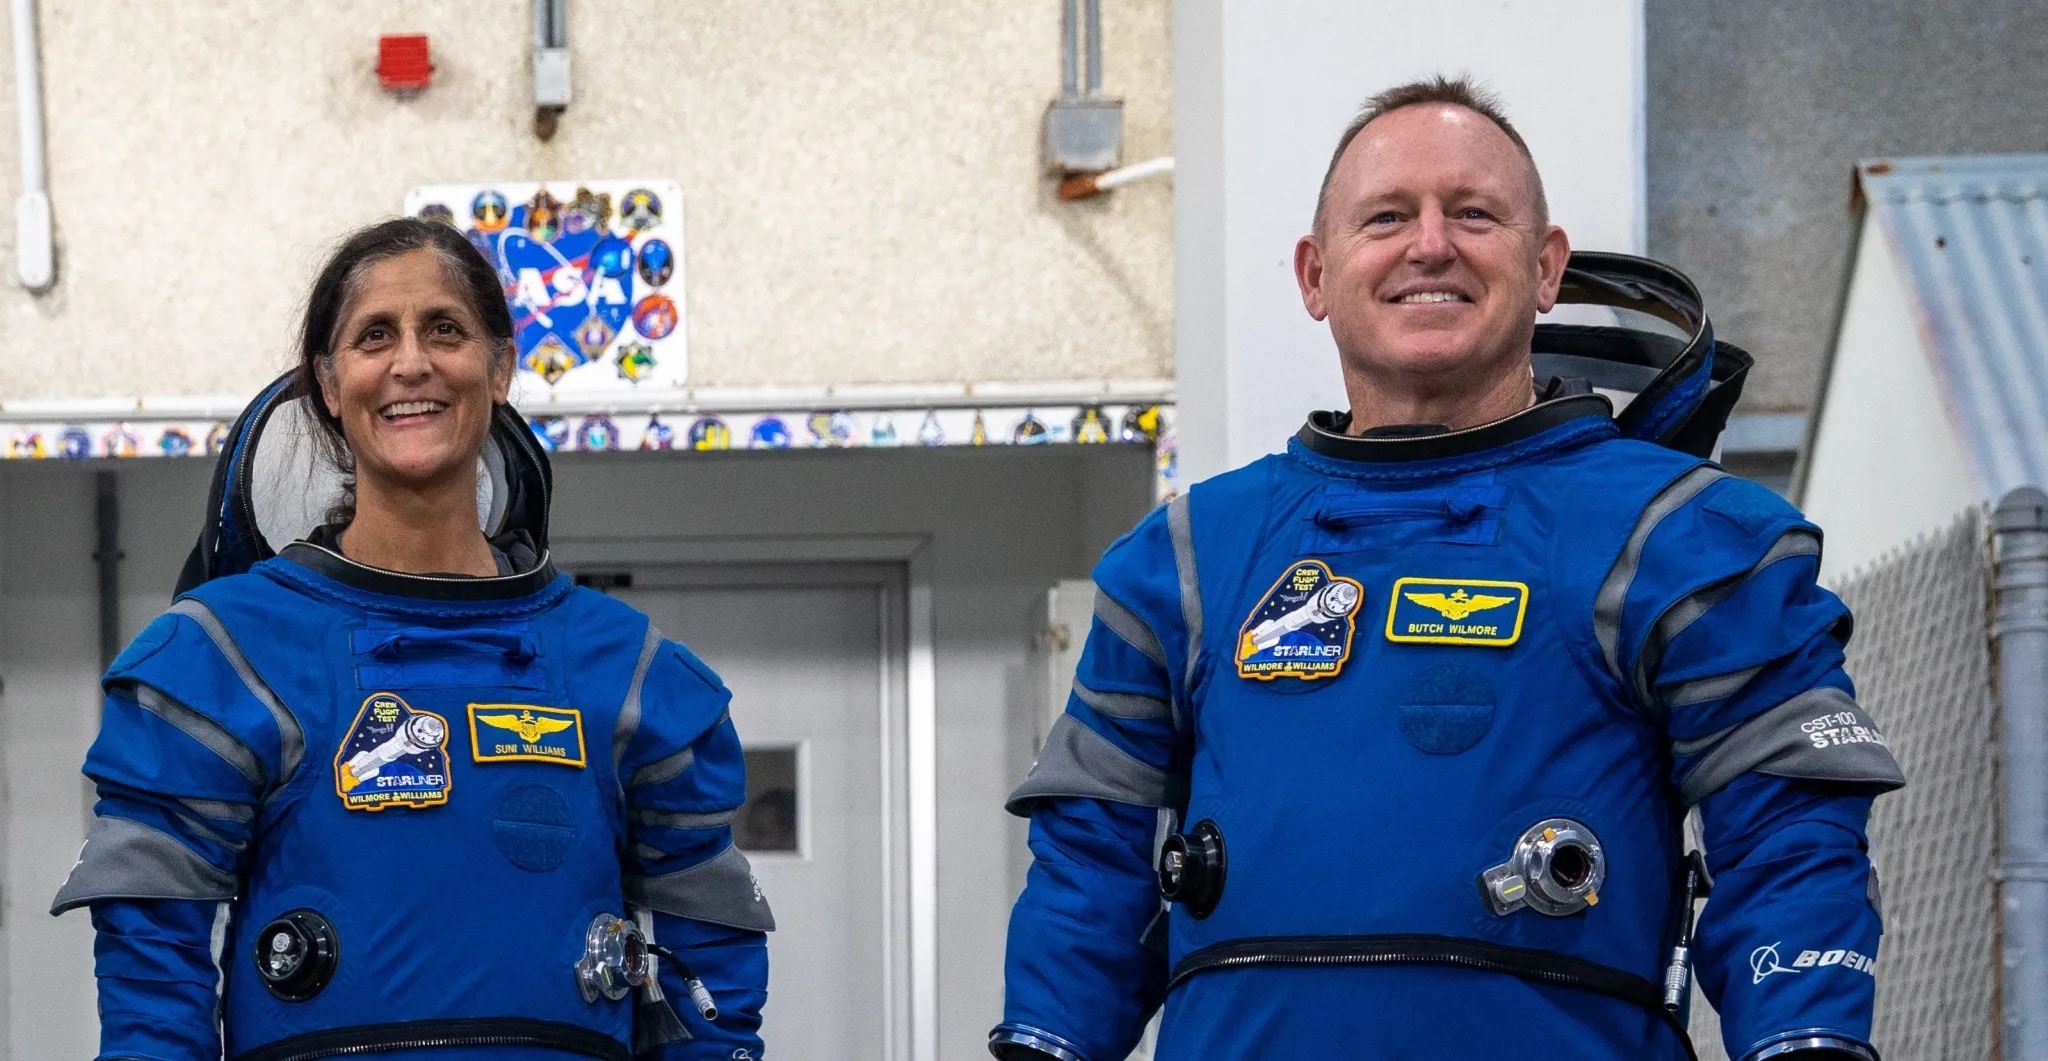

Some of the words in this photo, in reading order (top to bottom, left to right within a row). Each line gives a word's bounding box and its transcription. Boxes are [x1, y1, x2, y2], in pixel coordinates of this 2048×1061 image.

[515, 265, 627, 307] ASA
[1293, 576, 1319, 584] FLIGHT
[1408, 623, 1444, 633] BUTCH
[1449, 624, 1498, 636] WILMORE
[1273, 645, 1341, 657] STARLINER
[1243, 662, 1283, 672] WILMORE
[1293, 662, 1335, 670] WILLIAMS
[374, 708, 400, 716] FLIGHT
[1801, 711, 1857, 733] CST-100
[1809, 725, 1887, 749] STARLI
[495, 743, 518, 754] SUNI
[522, 743, 567, 757] WILLIAMS
[376, 774, 444, 787] STARLINER
[349, 792, 391, 804] WILMORE
[400, 791, 442, 799] WILLIAMS
[1791, 949, 1876, 977] BOEIN
